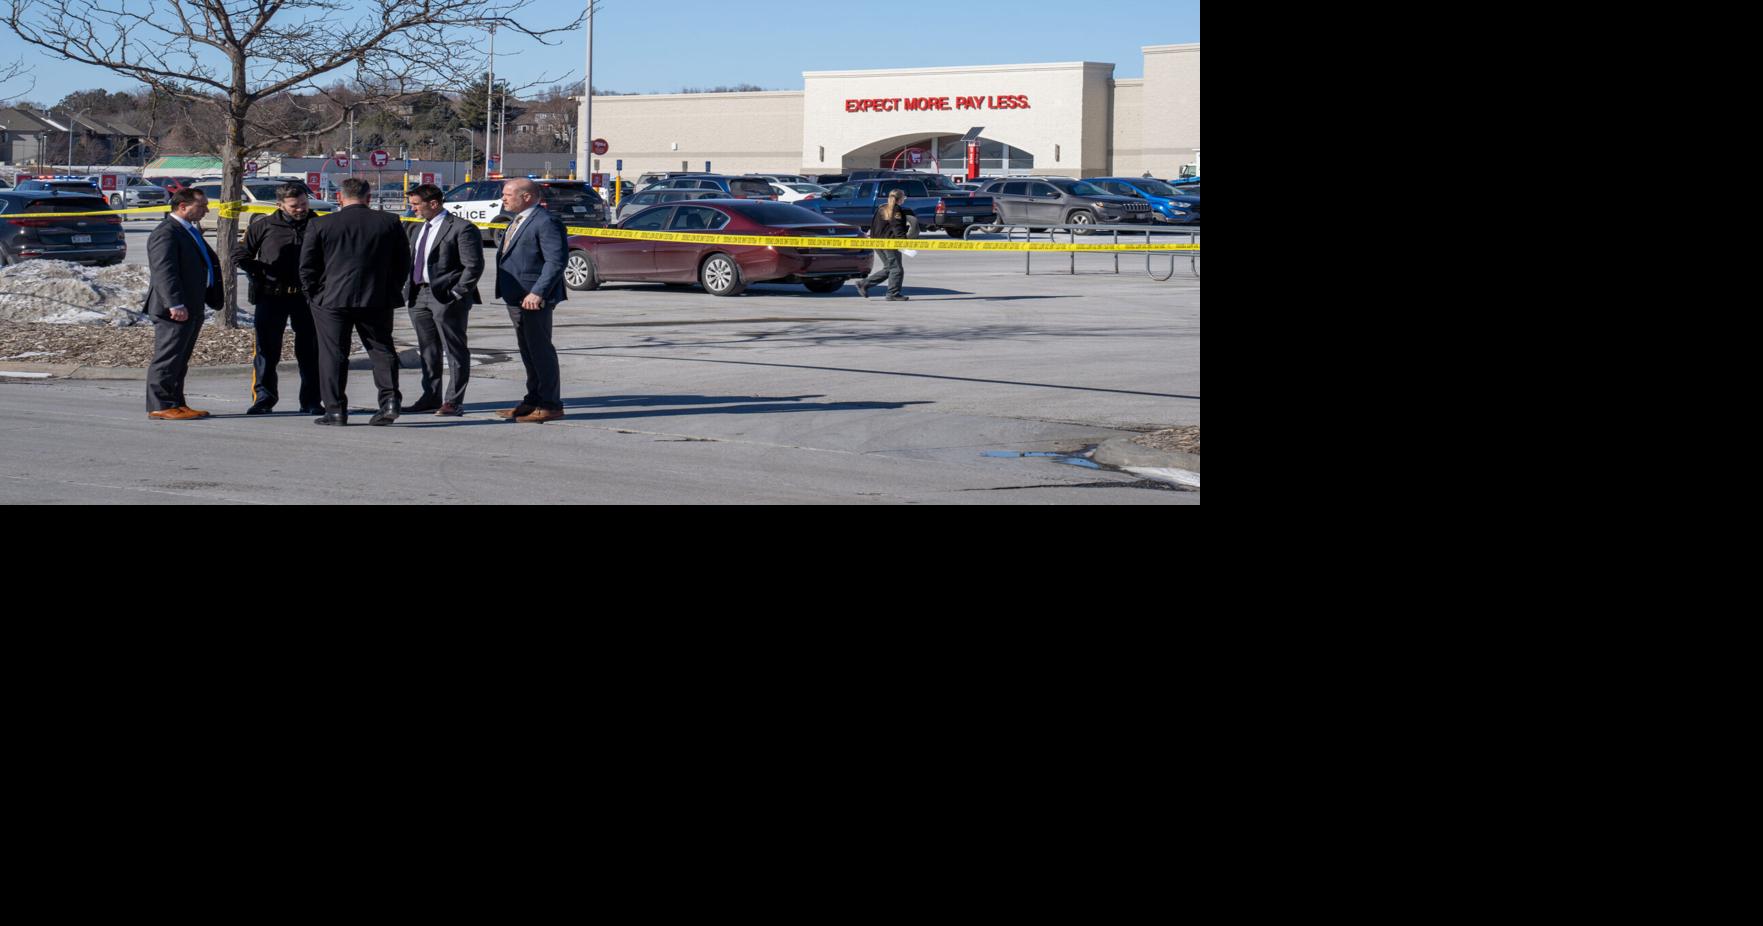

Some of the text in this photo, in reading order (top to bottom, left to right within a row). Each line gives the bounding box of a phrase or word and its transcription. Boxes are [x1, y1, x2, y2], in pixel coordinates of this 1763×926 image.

[845, 95, 1031, 112] EXPECT MORE. PAY LESS.
[451, 210, 486, 219] OLICE
